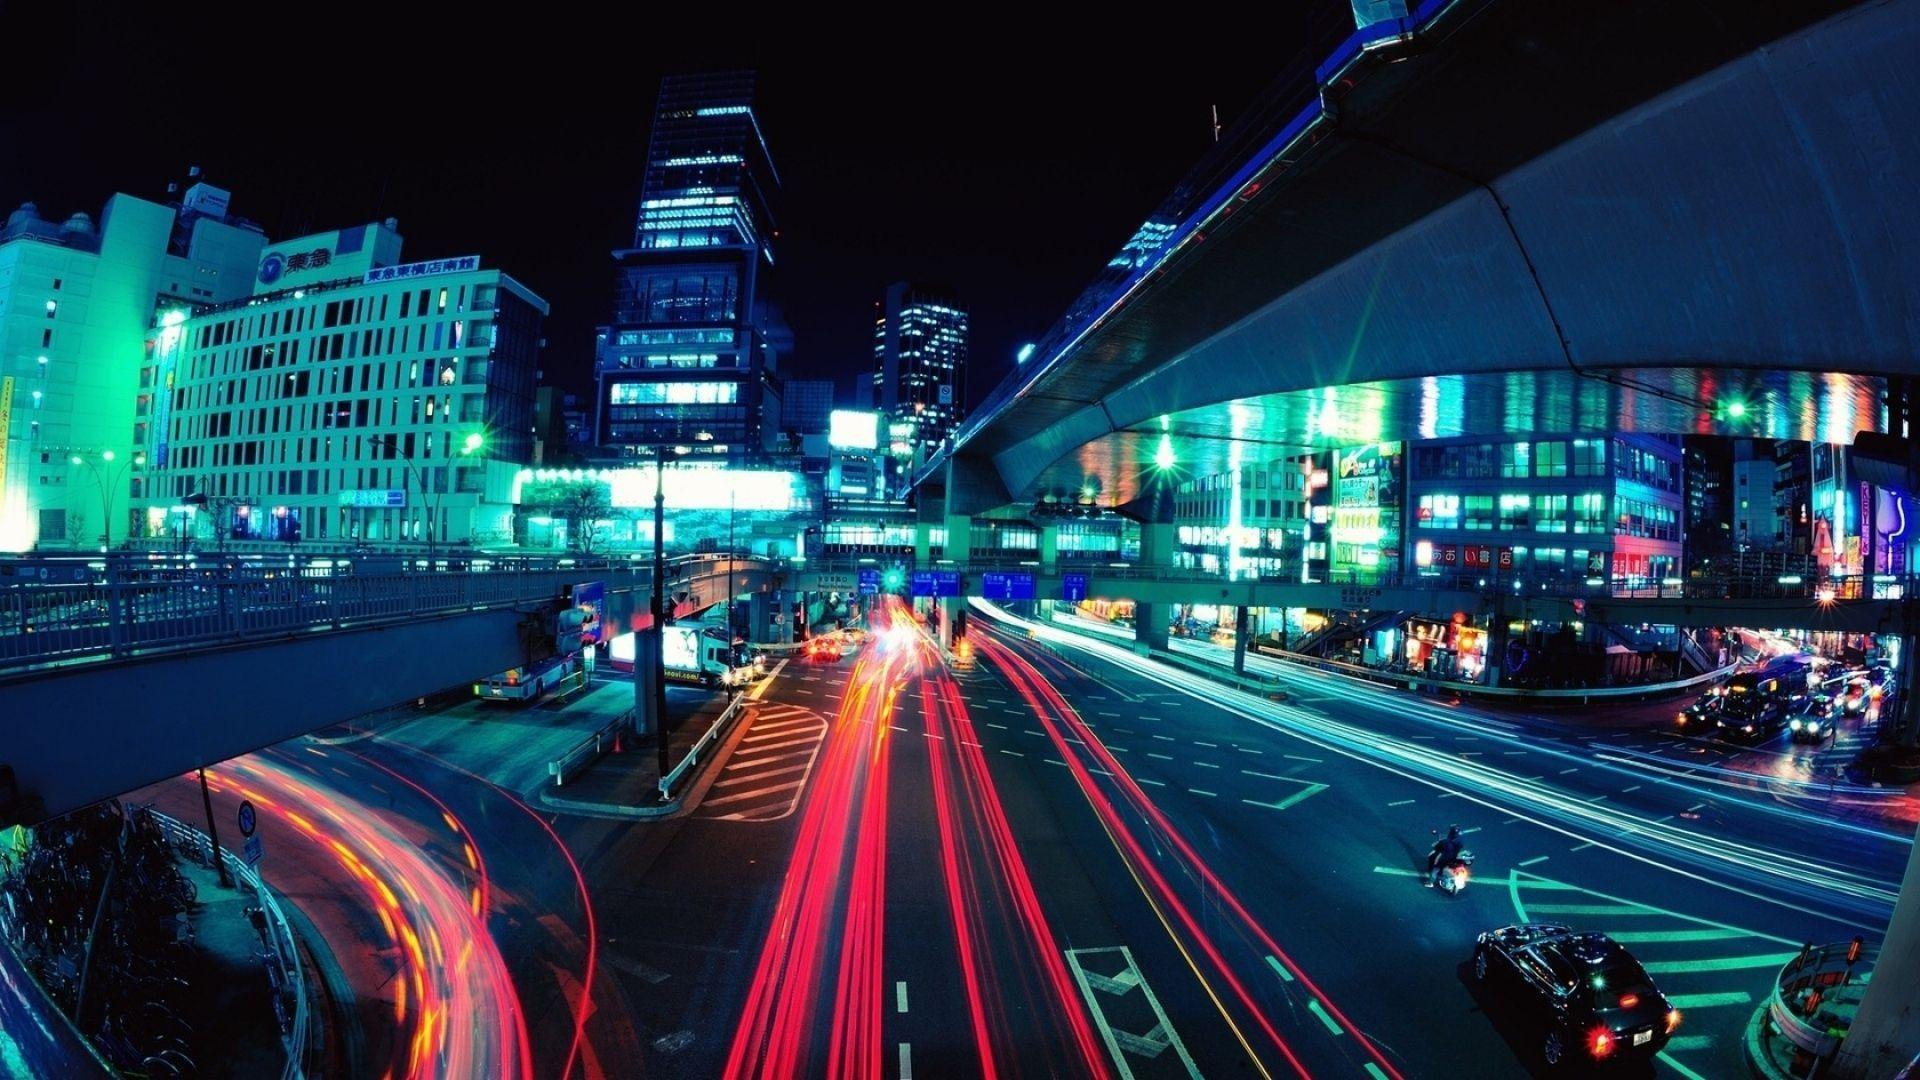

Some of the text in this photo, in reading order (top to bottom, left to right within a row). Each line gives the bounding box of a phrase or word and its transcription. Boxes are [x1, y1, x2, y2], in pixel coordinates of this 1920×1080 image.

[286, 248, 332, 274] 東急
[1432, 549, 1512, 564] あおい書店
